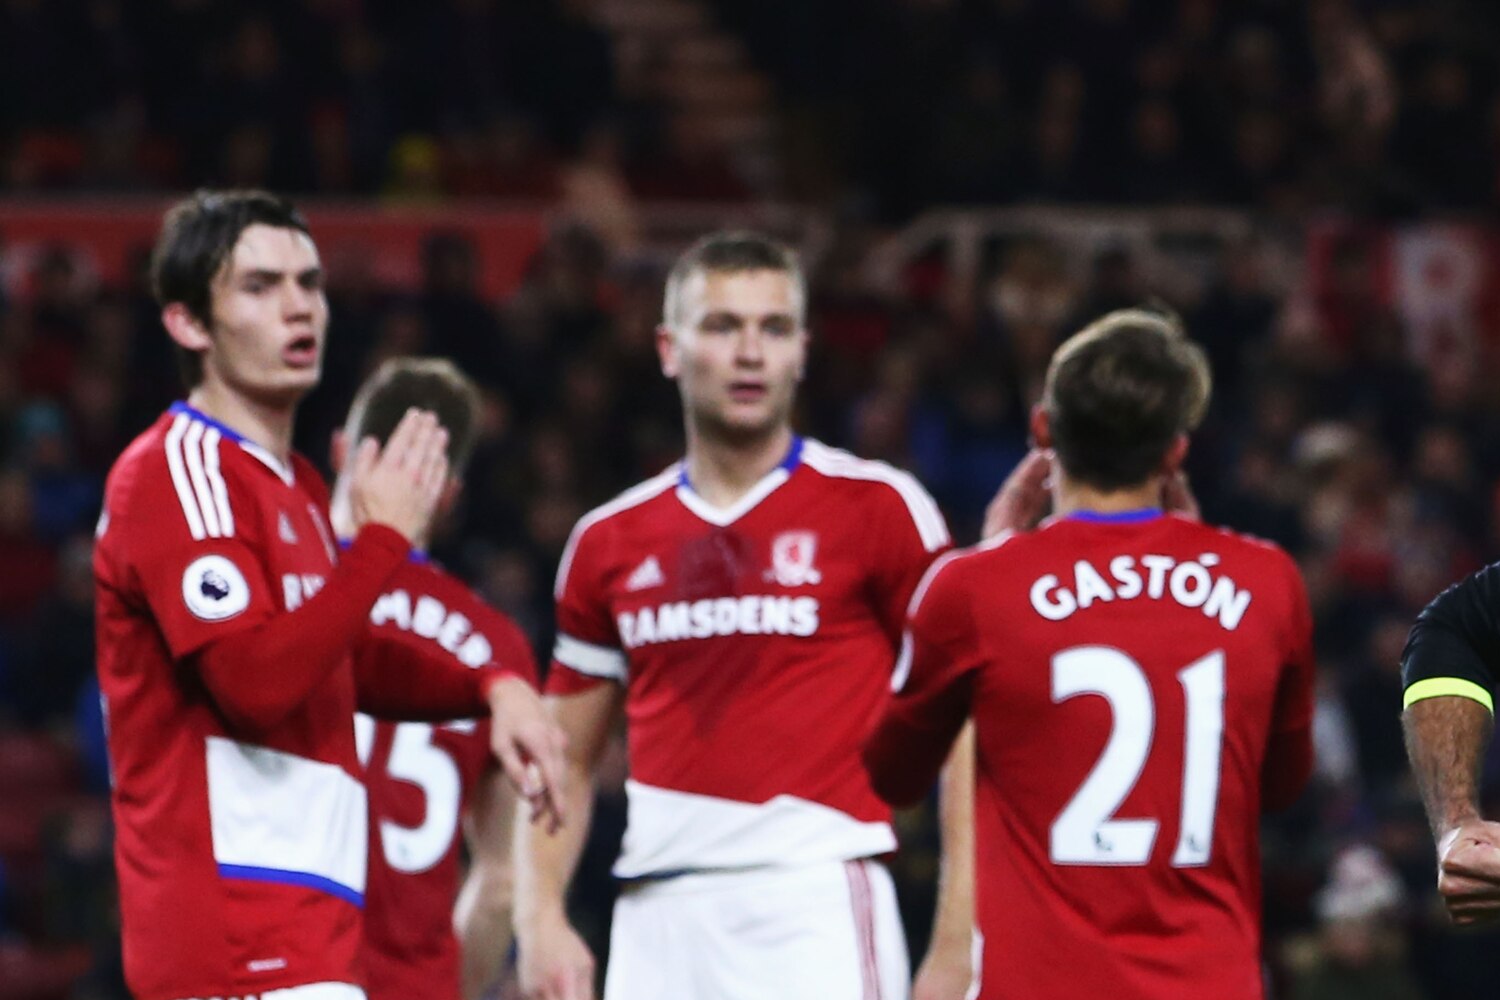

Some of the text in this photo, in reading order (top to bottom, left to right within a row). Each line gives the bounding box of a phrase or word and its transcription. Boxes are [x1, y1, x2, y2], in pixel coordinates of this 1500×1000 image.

[617, 594, 820, 649] RAMSDENS
[1029, 553, 1252, 631] GASTÓN
[1048, 643, 1227, 868] 21
